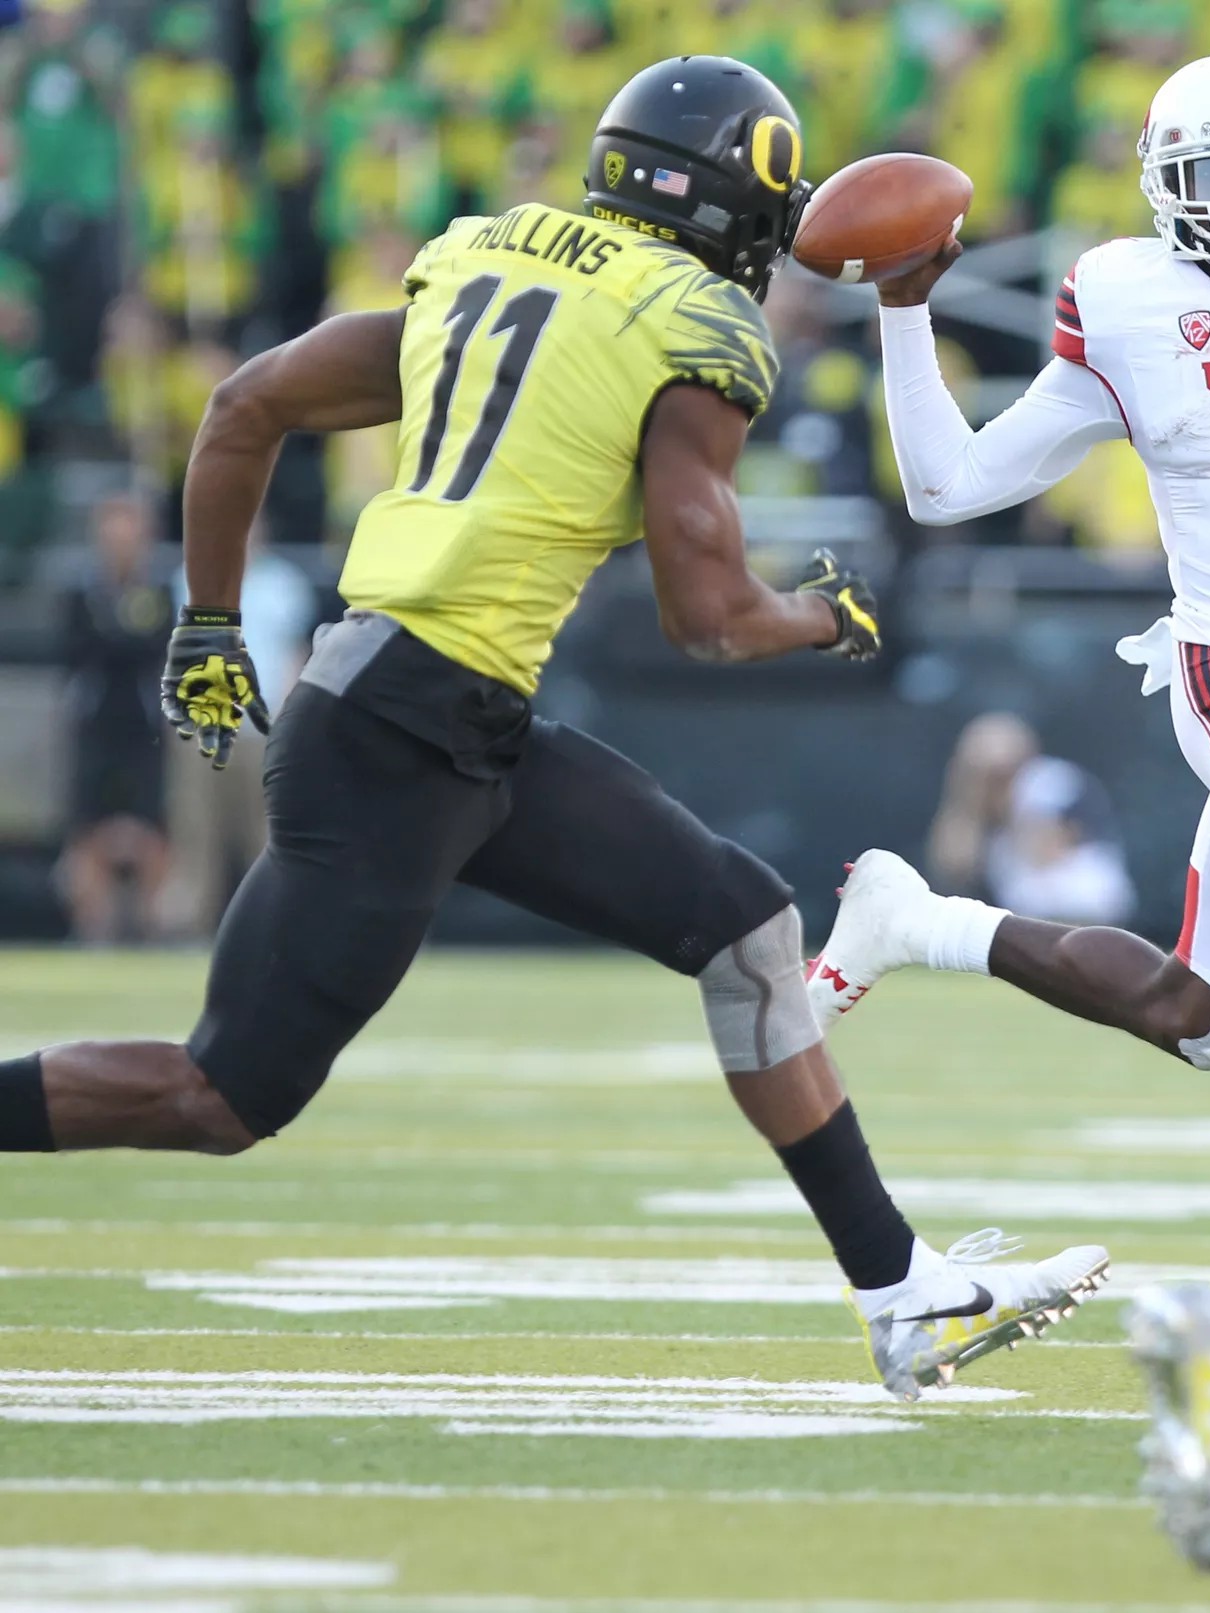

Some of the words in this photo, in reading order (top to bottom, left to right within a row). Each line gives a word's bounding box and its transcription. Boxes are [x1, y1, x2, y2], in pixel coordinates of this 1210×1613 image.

[467, 207, 622, 275] HOLLINS
[593, 205, 677, 241] DUCKS
[1180, 311, 1210, 336] PAC
[1188, 327, 1206, 343] 12
[406, 273, 560, 501] 11
